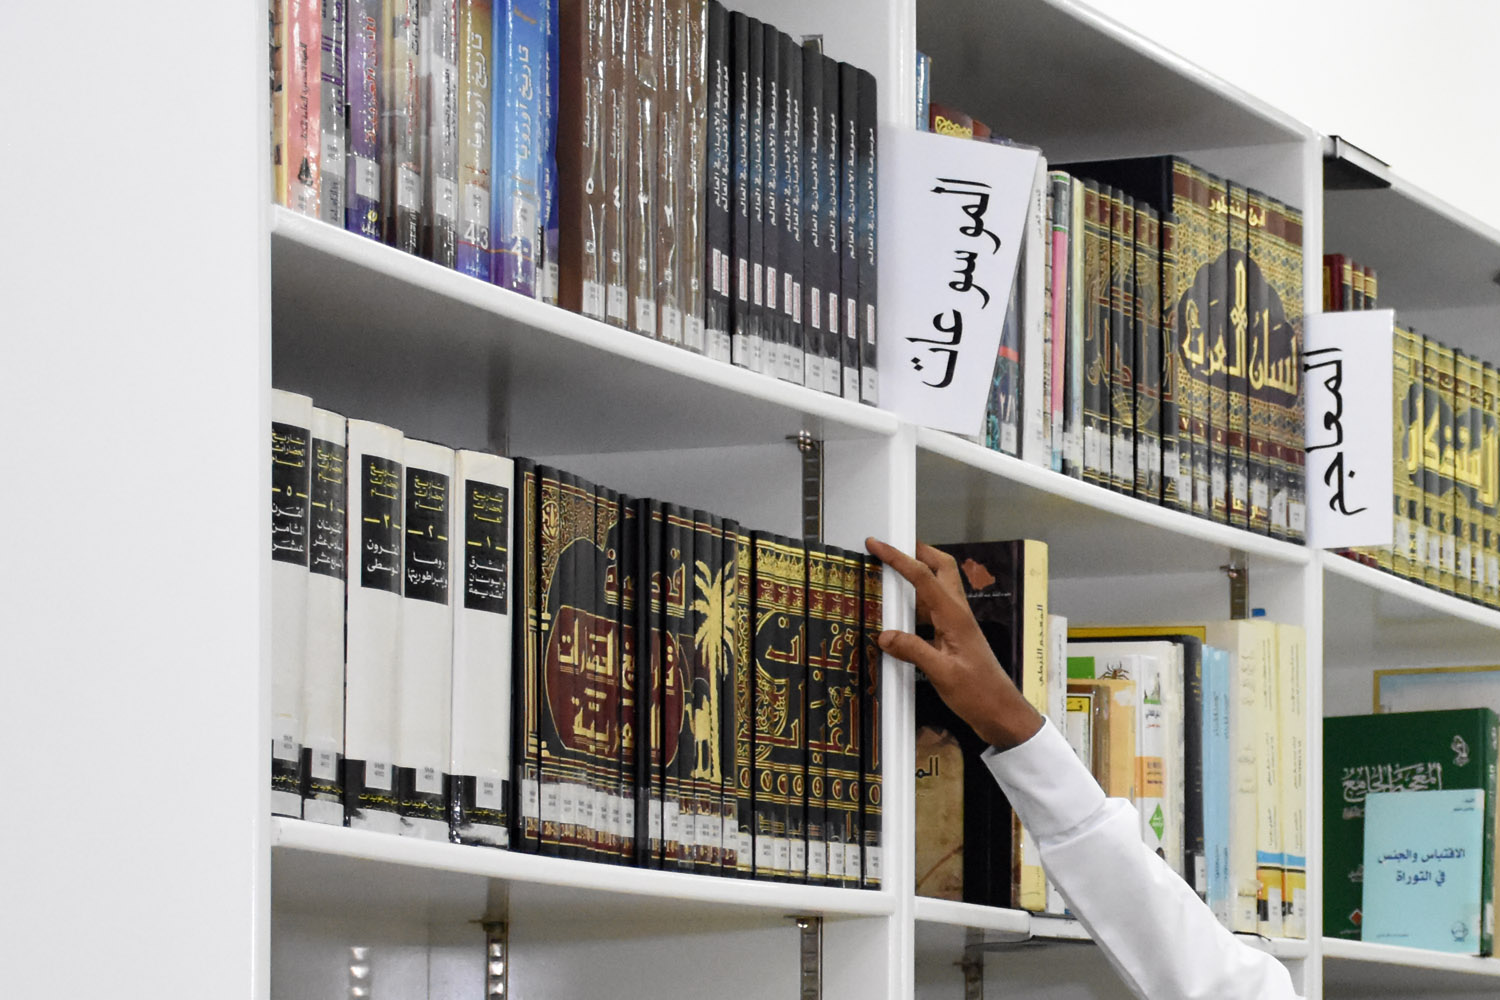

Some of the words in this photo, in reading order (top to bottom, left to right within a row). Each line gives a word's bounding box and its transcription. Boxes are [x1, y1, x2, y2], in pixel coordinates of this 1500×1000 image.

[470, 32, 489, 88] تاريخ
[517, 44, 534, 100] تاريخ
[904, 177, 1001, 389] الموسوعات
[1302, 348, 1367, 516] المعاجم
[1395, 870, 1432, 884] التوراة
[1421, 847, 1466, 863] الاقتباس
[1435, 871, 1446, 887] في
